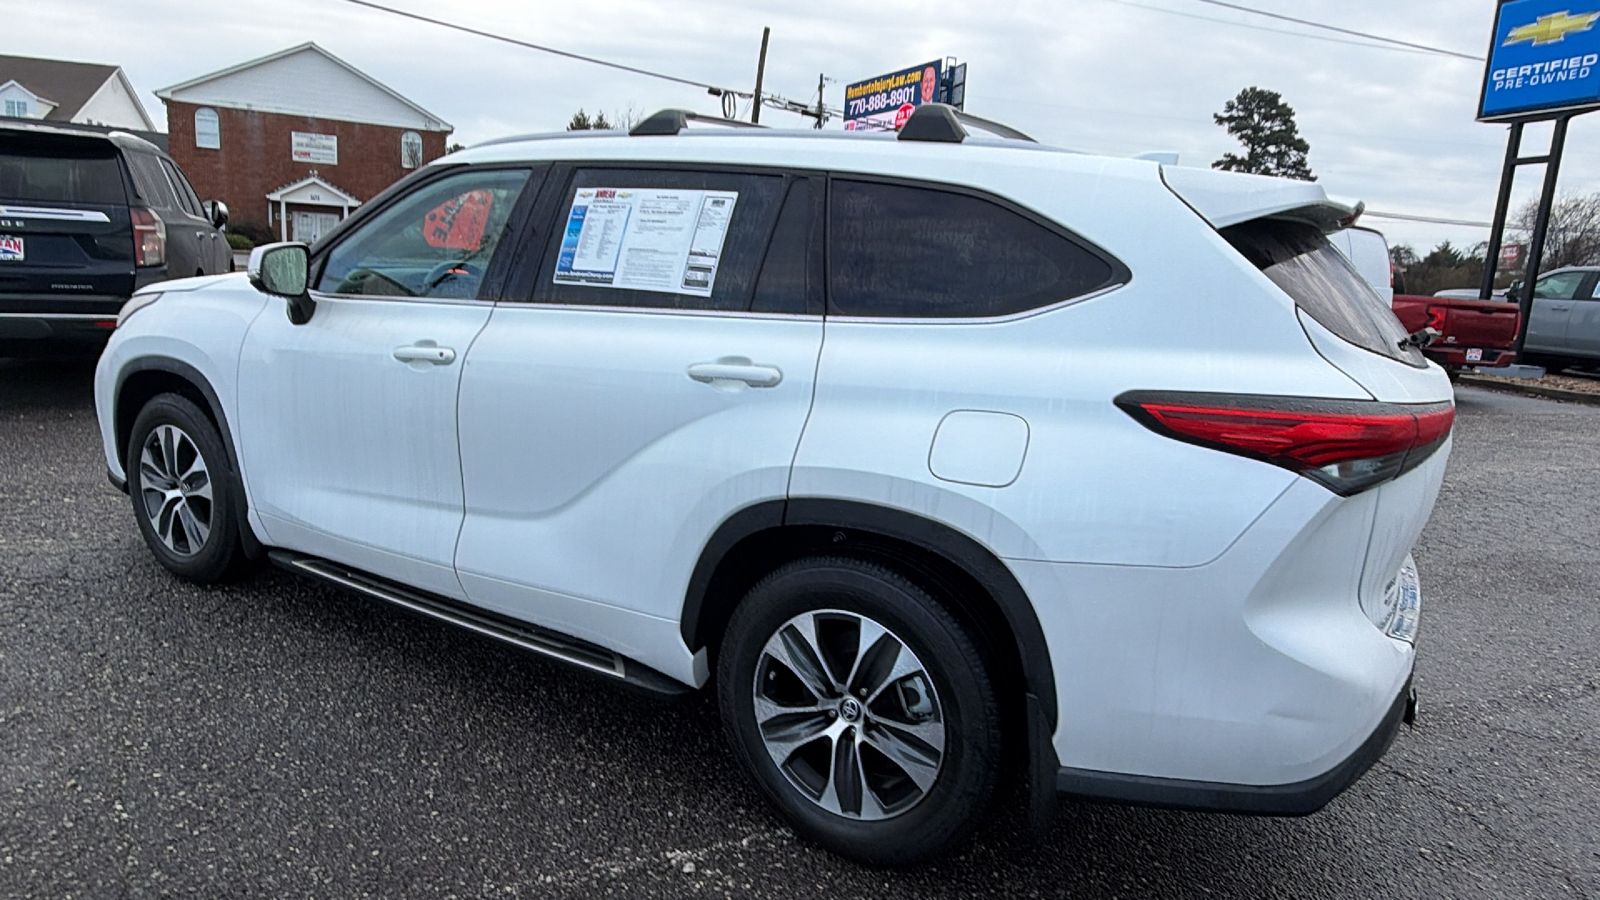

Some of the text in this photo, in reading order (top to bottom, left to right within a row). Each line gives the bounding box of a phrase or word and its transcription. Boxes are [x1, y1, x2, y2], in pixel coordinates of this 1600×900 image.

[1493, 53, 1598, 81] CERTIFIED
[1495, 66, 1590, 92] PRE-OWNED
[847, 70, 921, 99] HumbertoInjuryLaw.com
[849, 85, 915, 116] 770-888-8901
